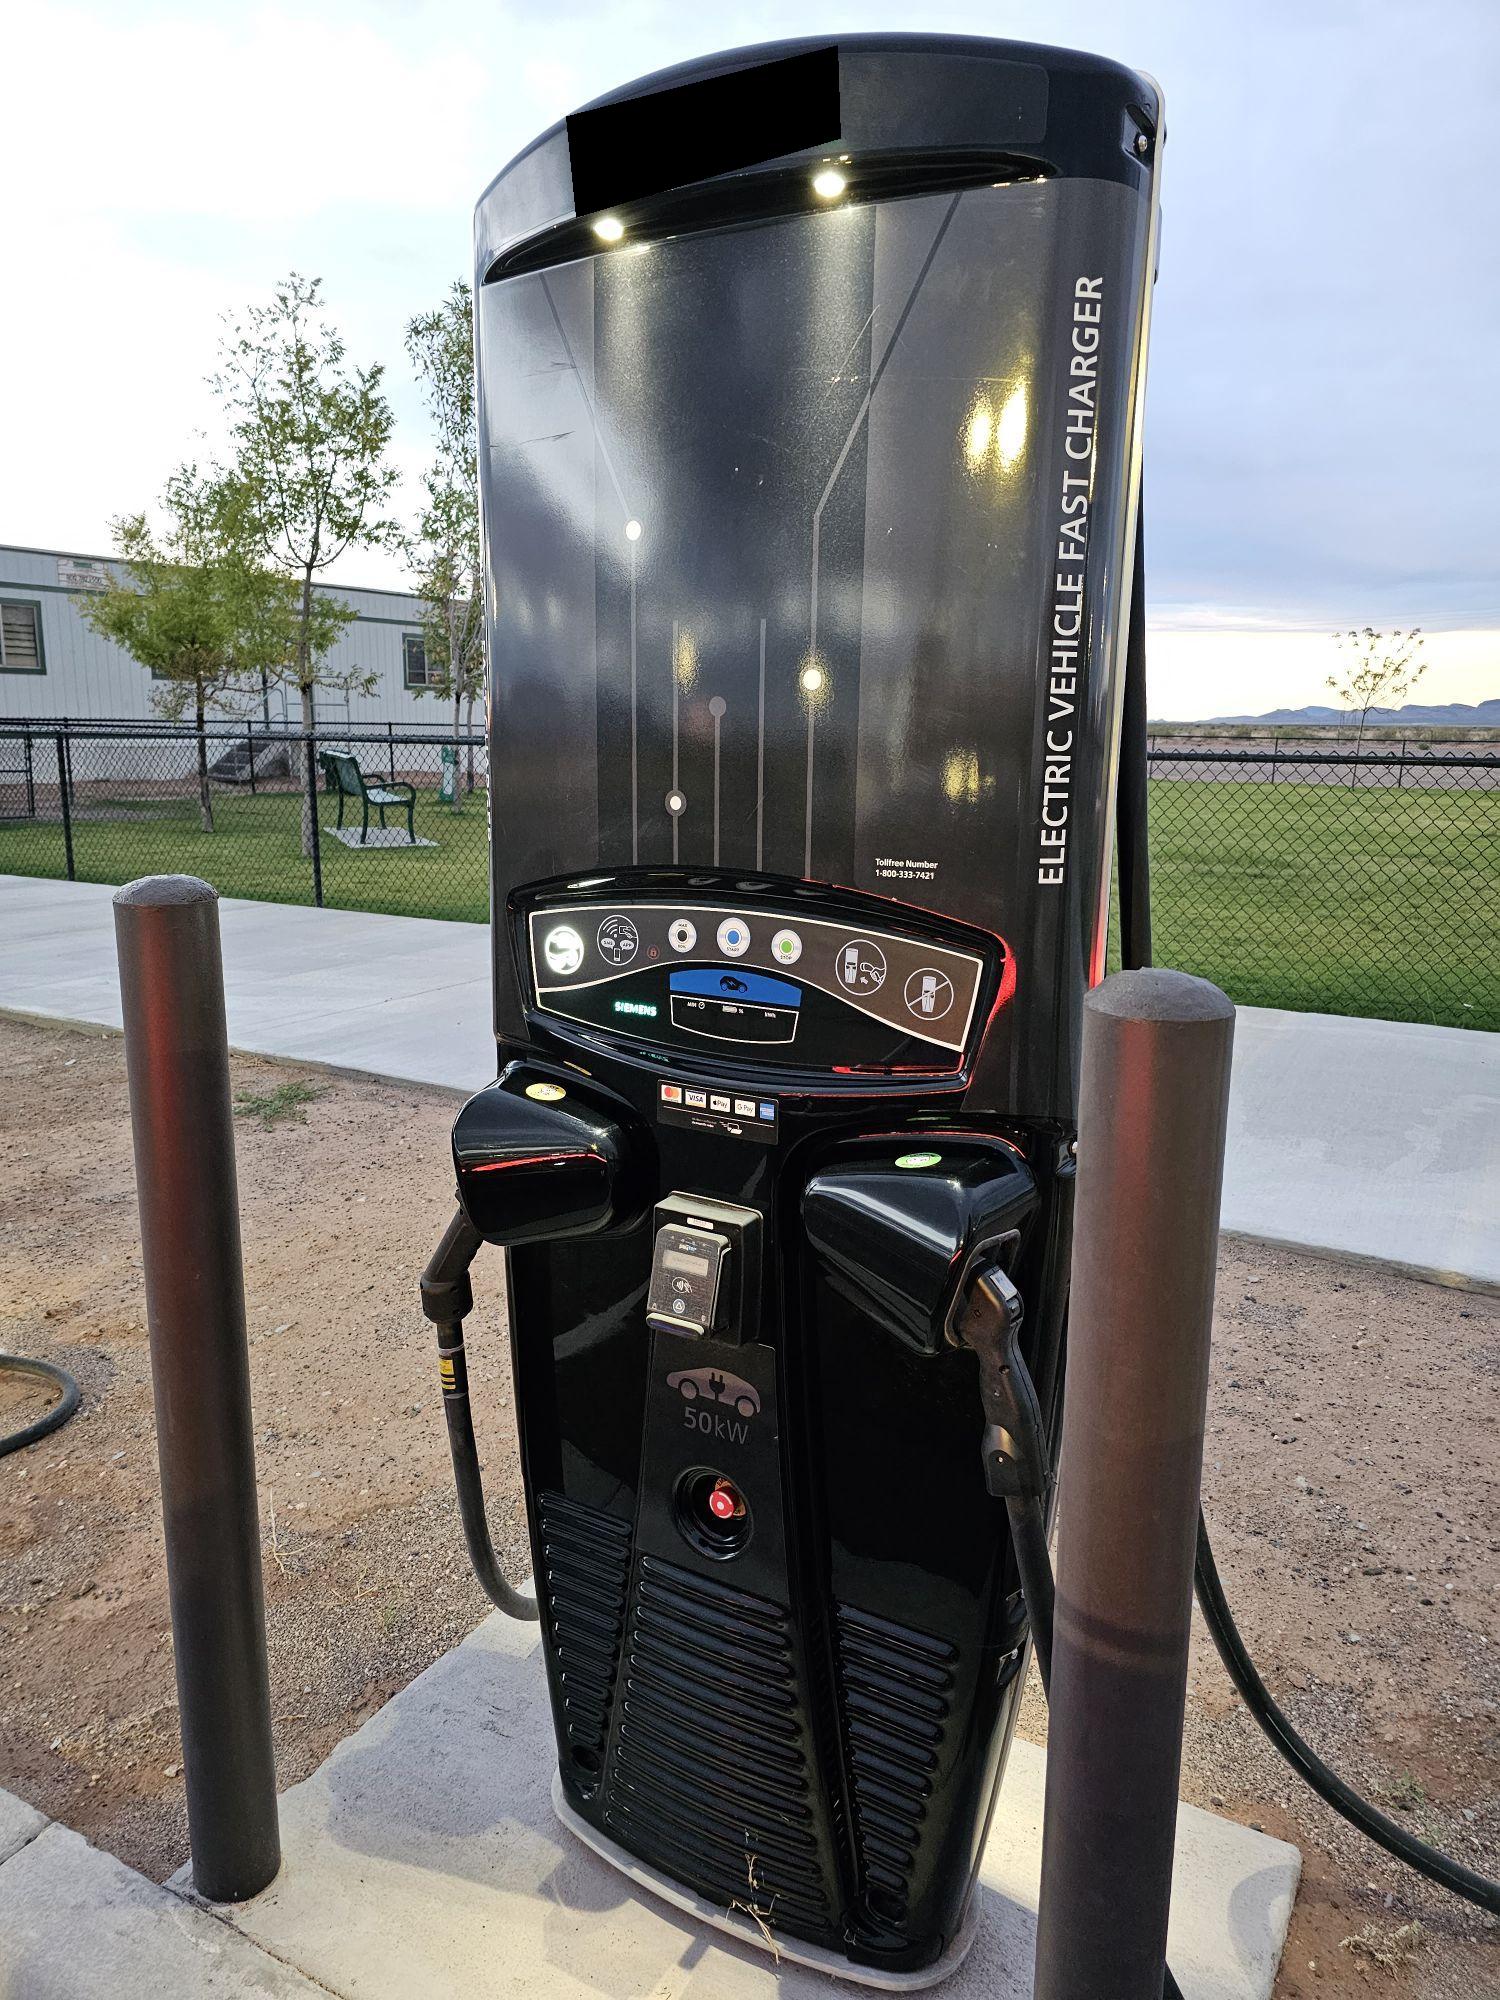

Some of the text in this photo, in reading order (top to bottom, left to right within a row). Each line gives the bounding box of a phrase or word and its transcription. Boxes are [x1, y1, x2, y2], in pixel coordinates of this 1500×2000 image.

[1038, 276, 1104, 885] ELECTRIC VEHICLE FAST CHARGER
[875, 858, 939, 869] Tollfree Number
[875, 869, 935, 880] 1-800-333-7421
[614, 1001, 657, 1017] SIEMENS
[687, 1093, 704, 1103] VISA
[717, 1100, 728, 1109] Pay
[683, 1406, 749, 1445] 50kW
